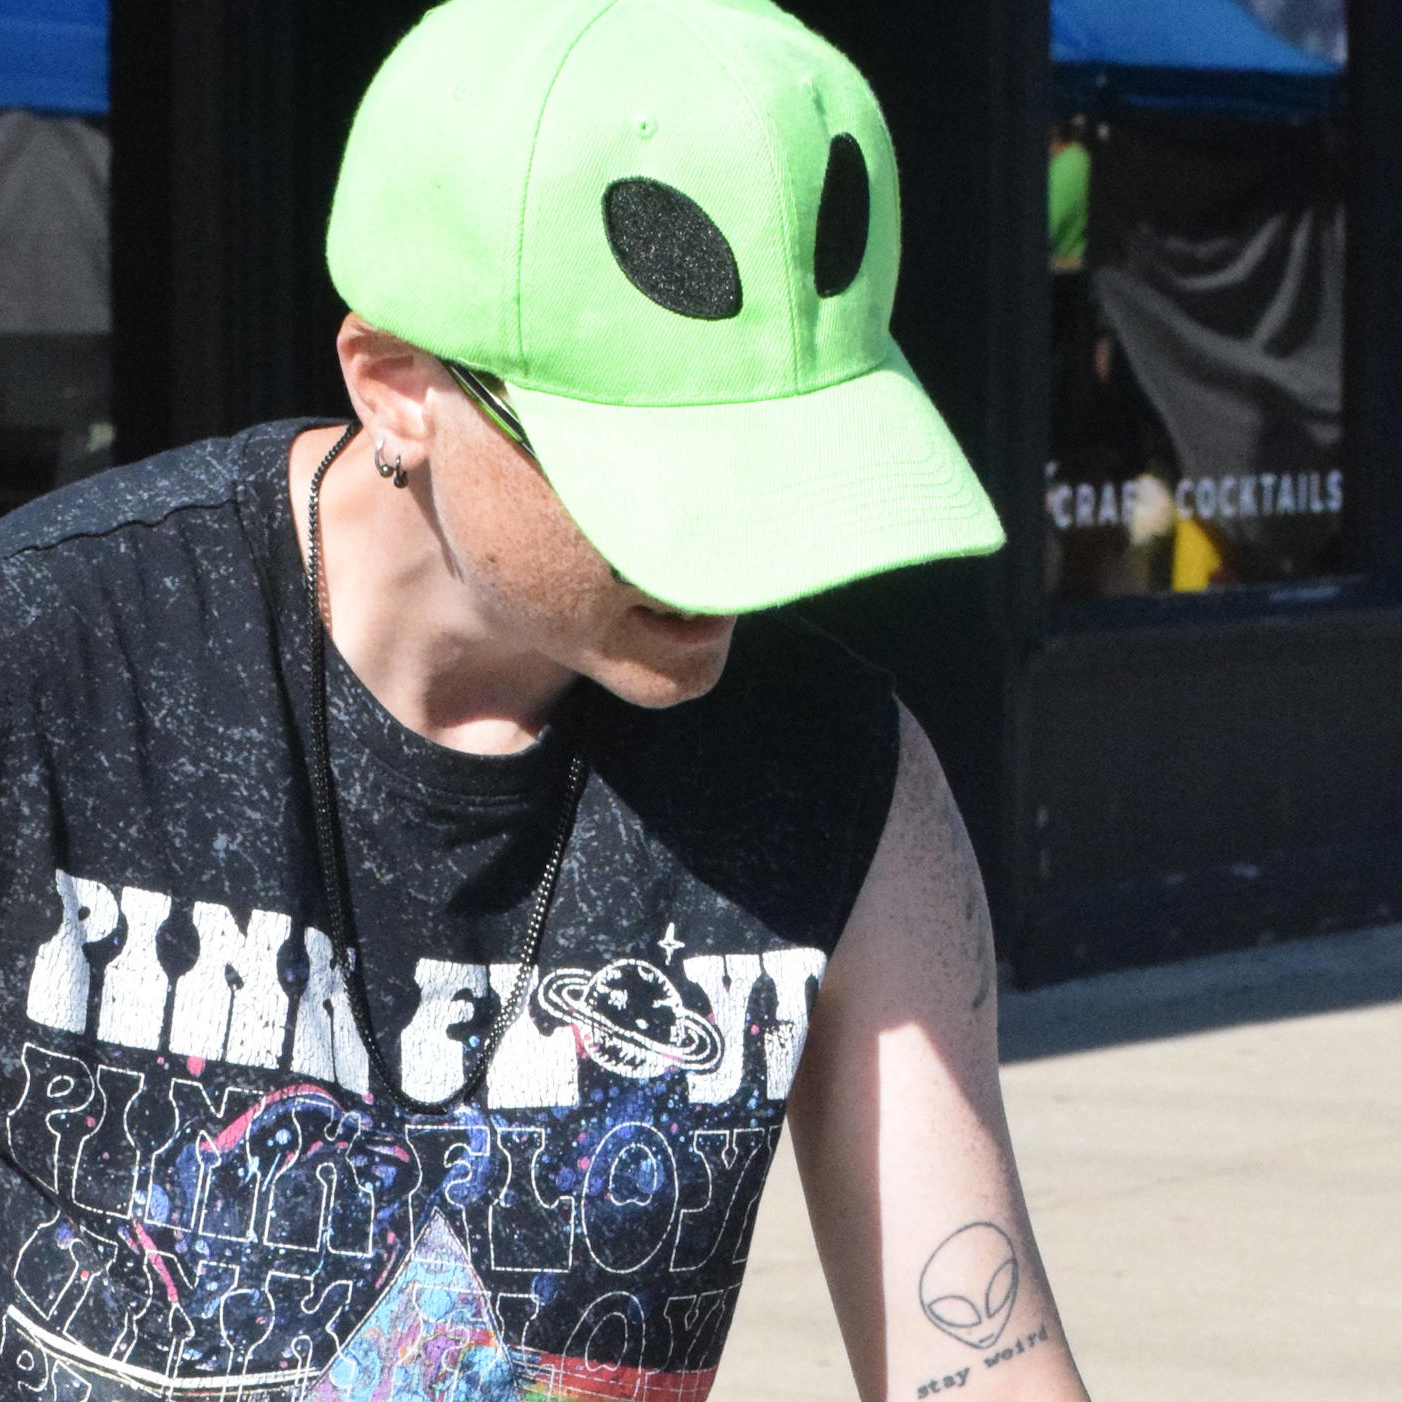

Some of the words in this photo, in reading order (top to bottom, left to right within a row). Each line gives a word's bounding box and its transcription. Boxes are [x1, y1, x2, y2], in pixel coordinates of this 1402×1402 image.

[1053, 477, 1158, 528] CRAF
[1175, 469, 1344, 519] COCKTAILS
[25, 867, 371, 1096] PINK
[5, 1041, 376, 1259] PINK
[917, 1366, 971, 1400] stay
[983, 1325, 1049, 1369] weird
